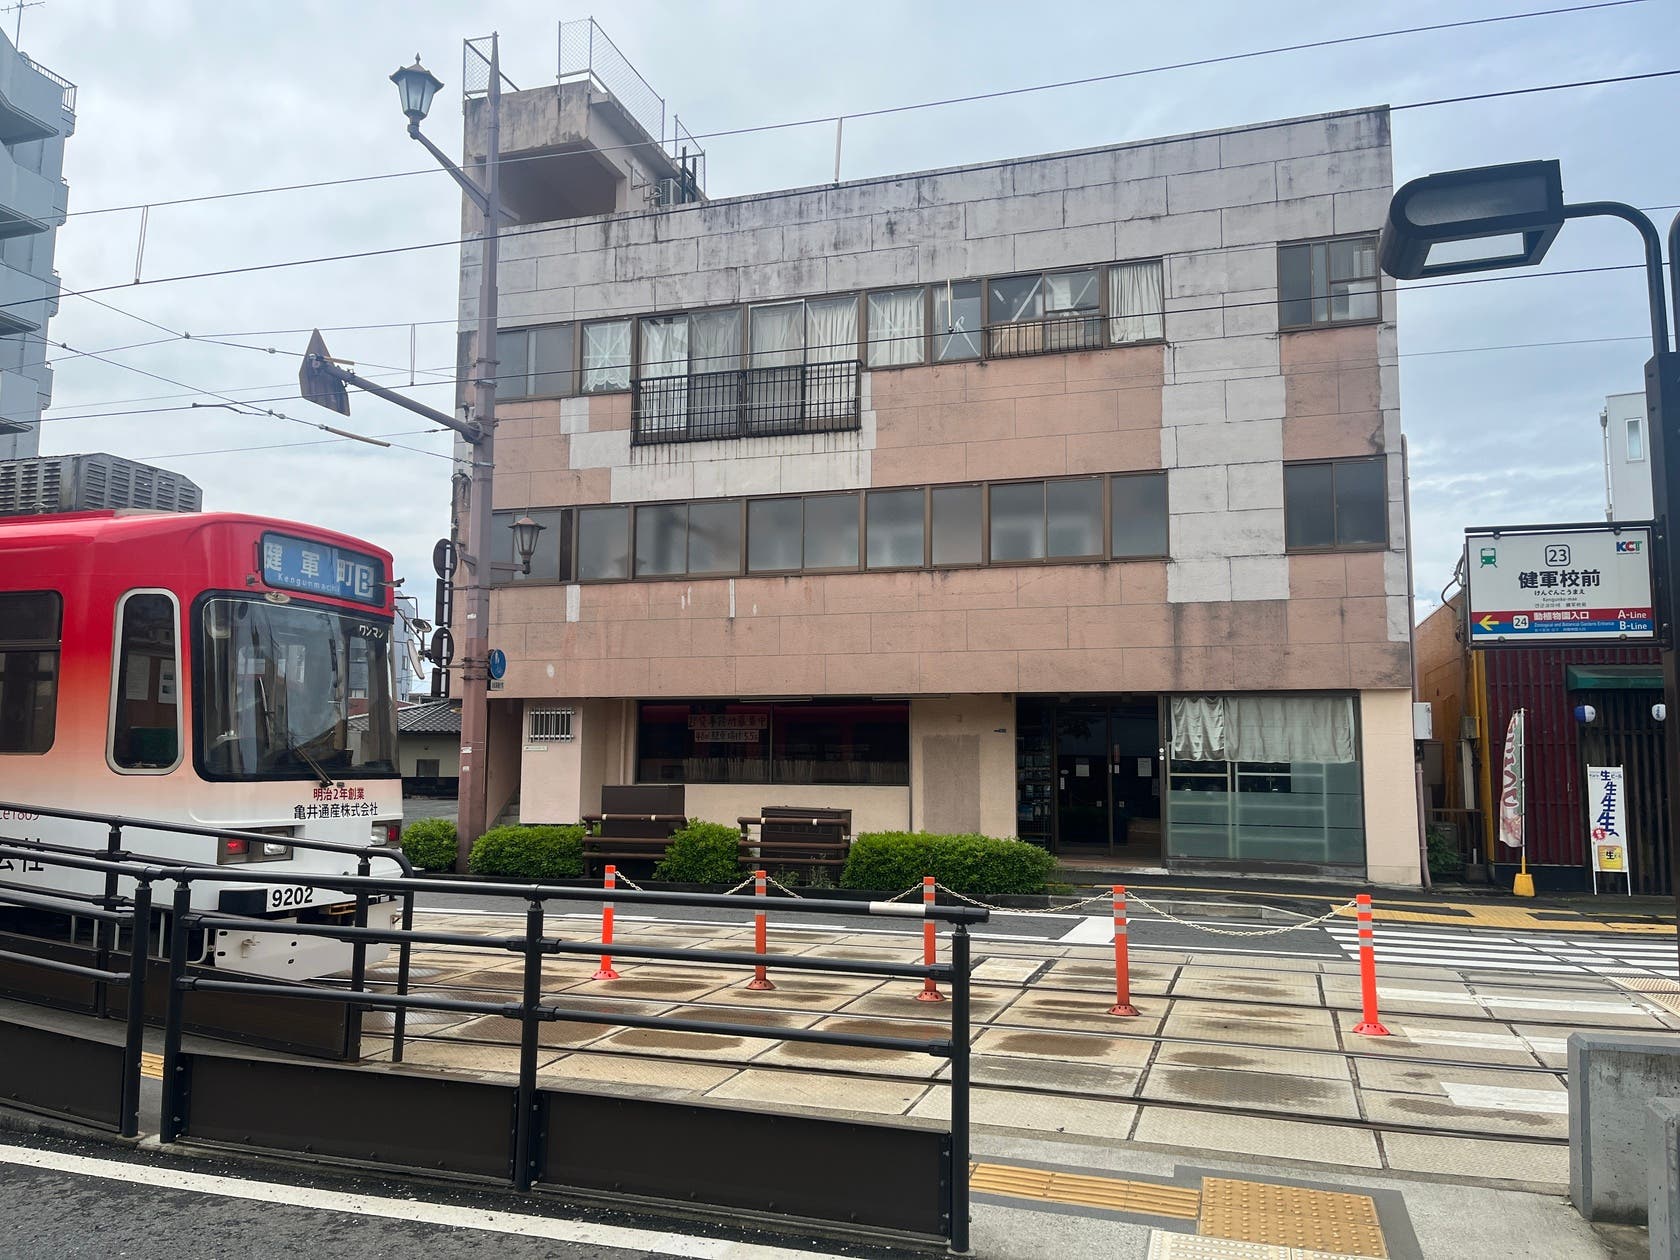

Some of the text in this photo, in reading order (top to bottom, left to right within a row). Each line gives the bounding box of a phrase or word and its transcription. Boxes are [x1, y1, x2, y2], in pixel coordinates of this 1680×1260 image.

[1616, 541, 1642, 552] KCT
[1548, 549, 1567, 563] 23
[277, 572, 341, 593] Kengunmachi
[1518, 569, 1601, 589] 健軍校前
[1533, 611, 1590, 621] 動植物園入口
[1617, 610, 1647, 619] A-Line
[1514, 618, 1527, 627] 24
[1619, 621, 1647, 631] B-Line
[359, 624, 384, 639] ワンマン
[313, 787, 365, 801] 明治2年創業
[293, 802, 379, 820] 亀井通産株式会社
[271, 886, 314, 908] 9202
